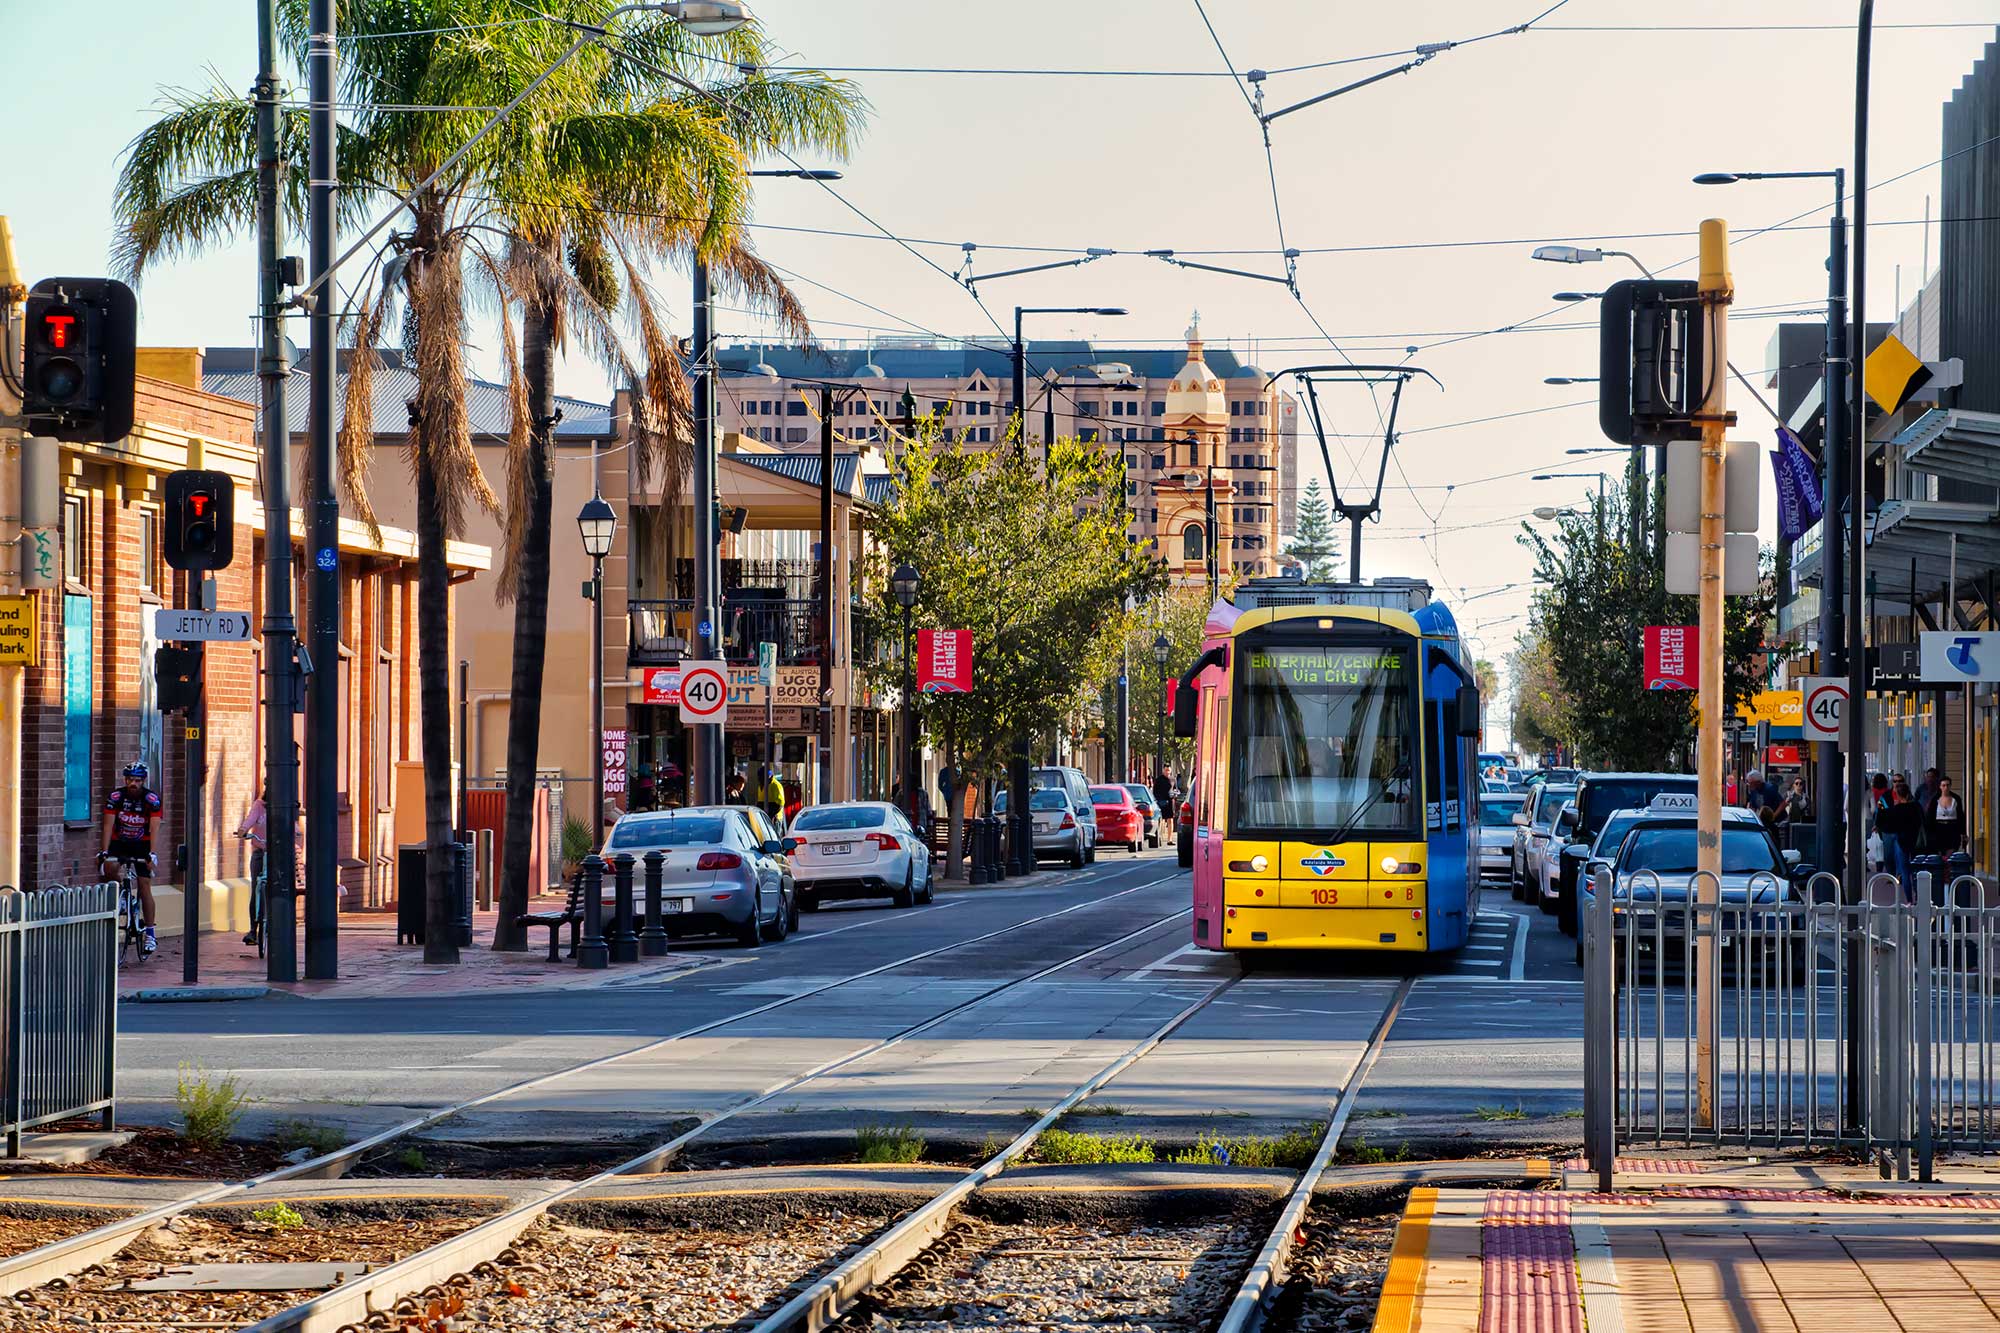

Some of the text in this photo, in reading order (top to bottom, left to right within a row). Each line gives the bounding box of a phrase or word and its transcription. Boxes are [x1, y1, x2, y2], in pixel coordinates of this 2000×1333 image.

[318, 558, 336, 567] 324
[175, 617, 234, 633] JETTY RD
[943, 632, 956, 678] GLENELG
[1670, 628, 1684, 676] GLENELG
[727, 670, 759, 684] THE
[783, 675, 817, 685] UGG
[1293, 670, 1358, 683] Via City
[688, 682, 718, 702] 40
[187, 730, 198, 738] 10
[612, 741, 626, 750] THE
[1660, 797, 1693, 807] TAXI
[1311, 889, 1338, 904] 103
[1406, 888, 1413, 900] B
